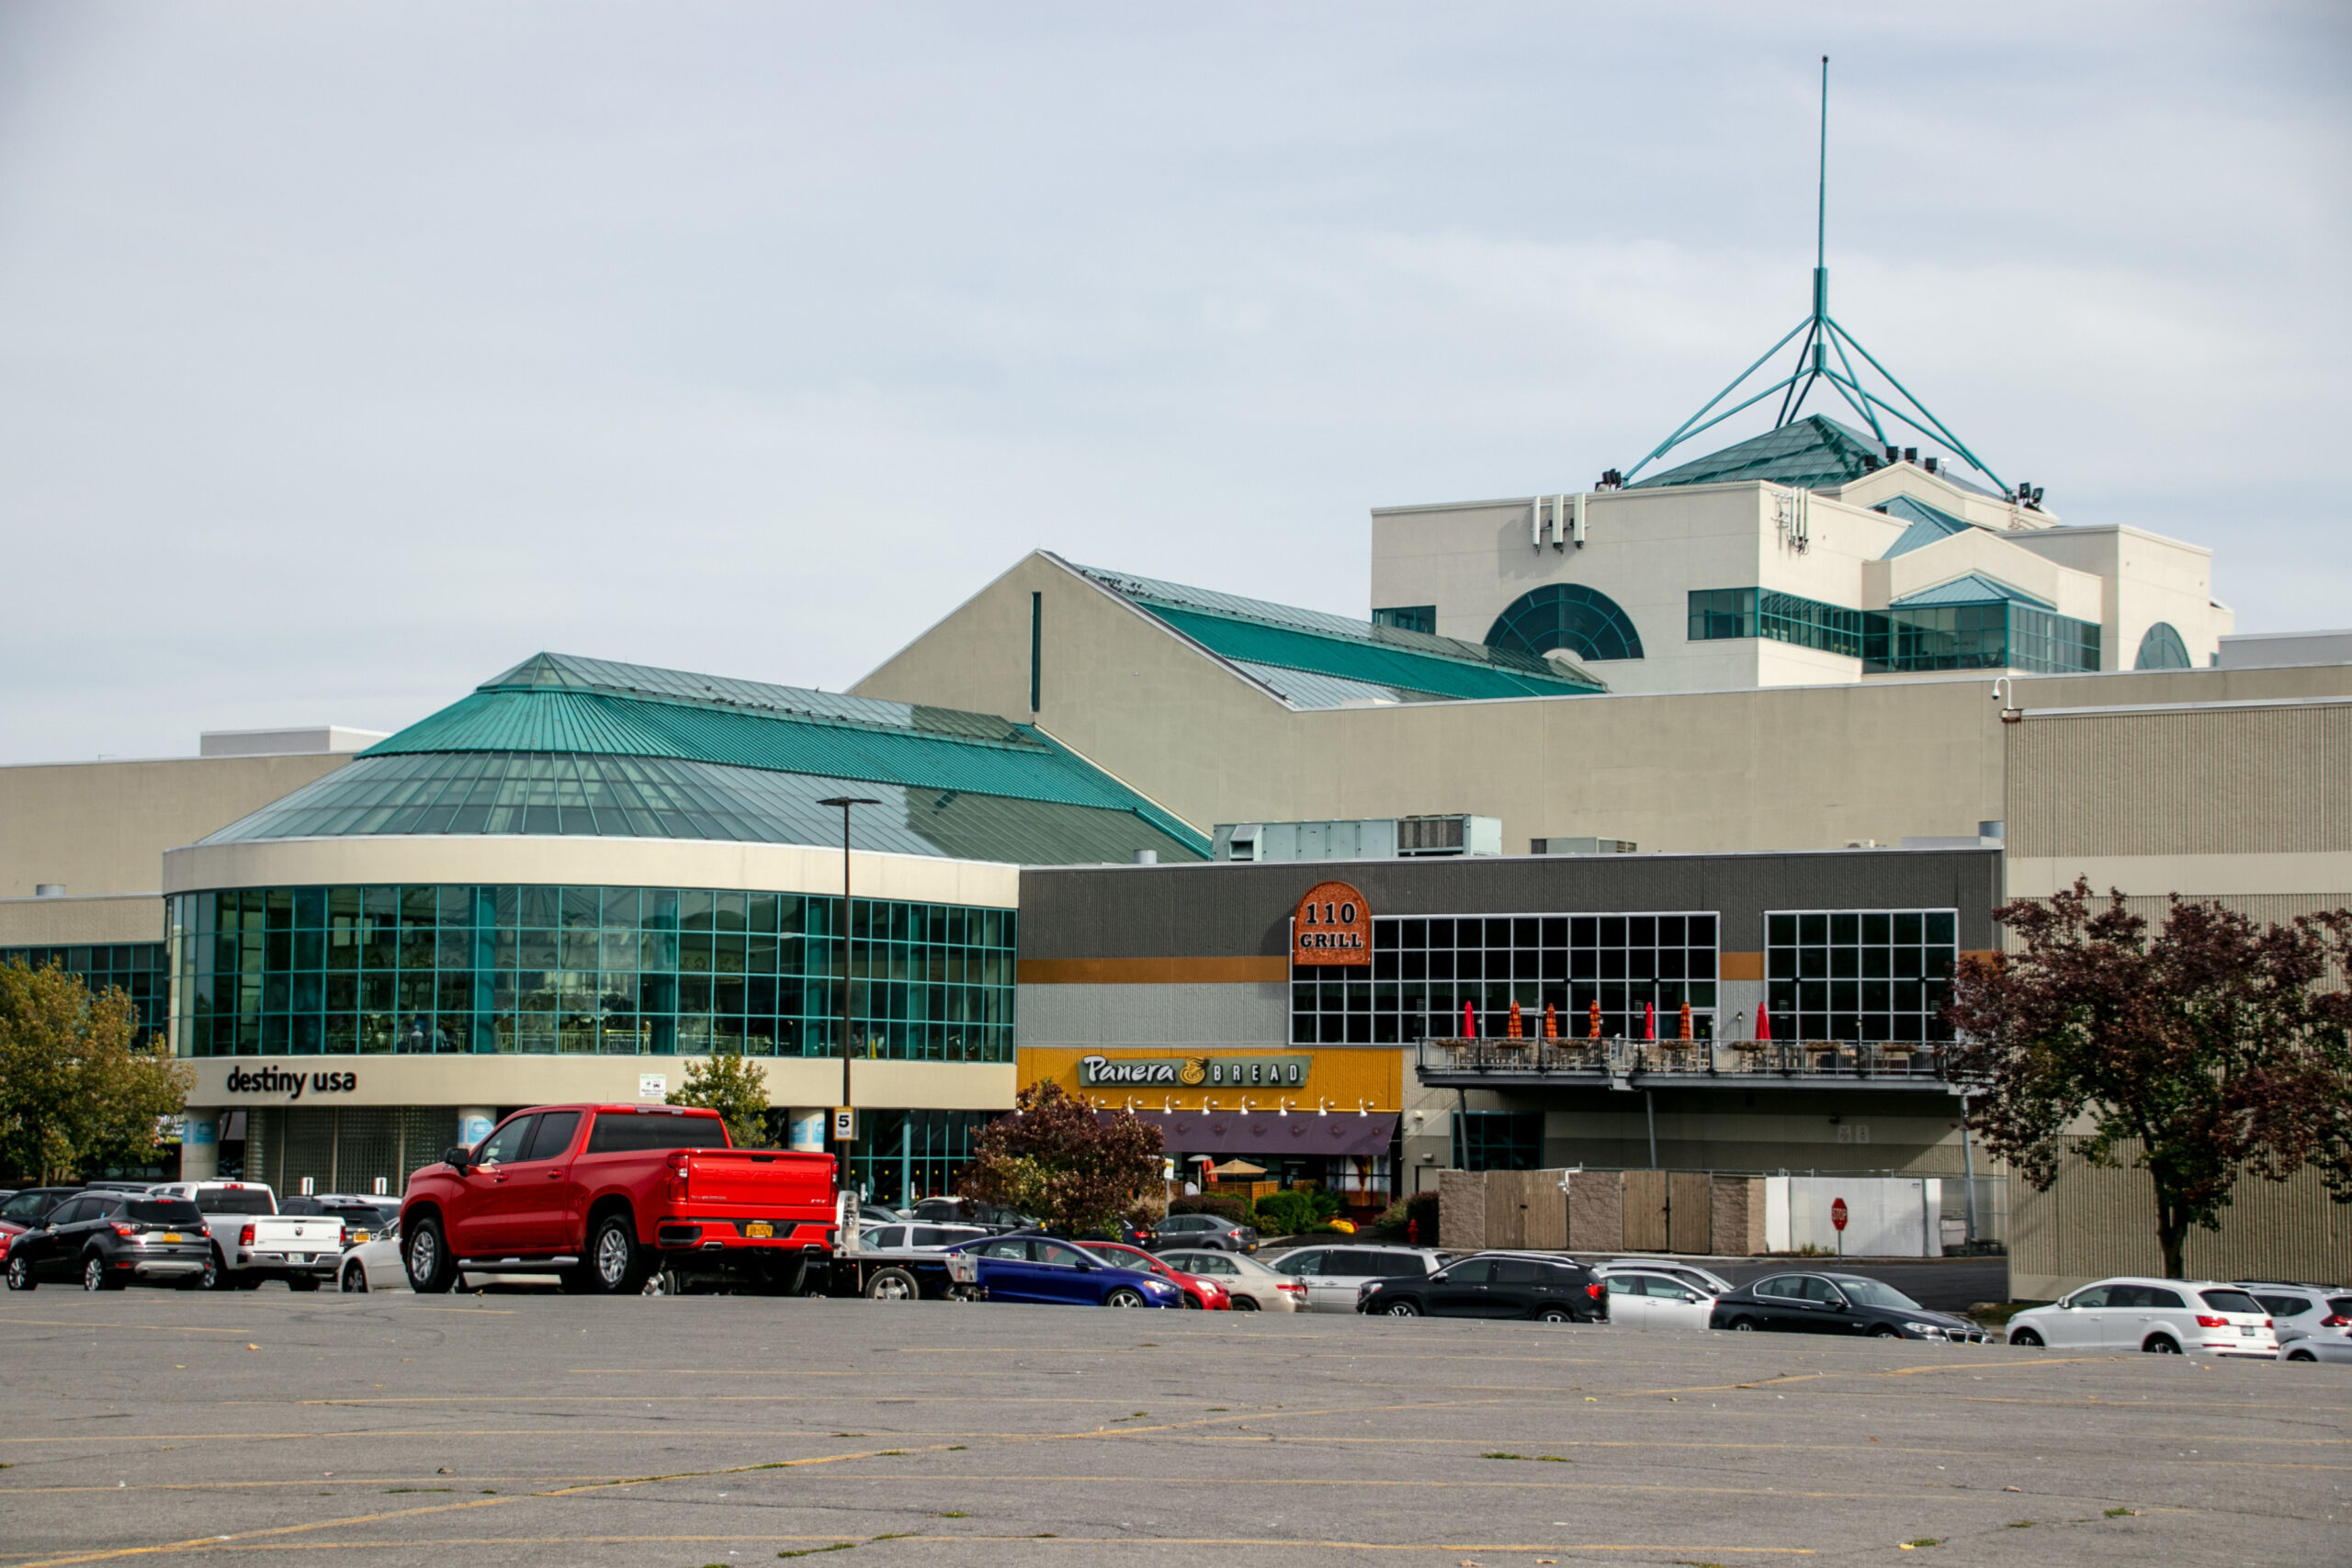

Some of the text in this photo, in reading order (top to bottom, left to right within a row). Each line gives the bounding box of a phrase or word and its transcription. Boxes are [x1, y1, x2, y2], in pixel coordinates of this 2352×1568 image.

[1306, 902, 1357, 925] 110
[1299, 932, 1363, 949] GRILL
[1083, 1055, 1300, 1082] Panera BREAD
[227, 1065, 357, 1100] destiny usa
[838, 1114, 850, 1128] 5
[1832, 1208, 1847, 1221] STOP
